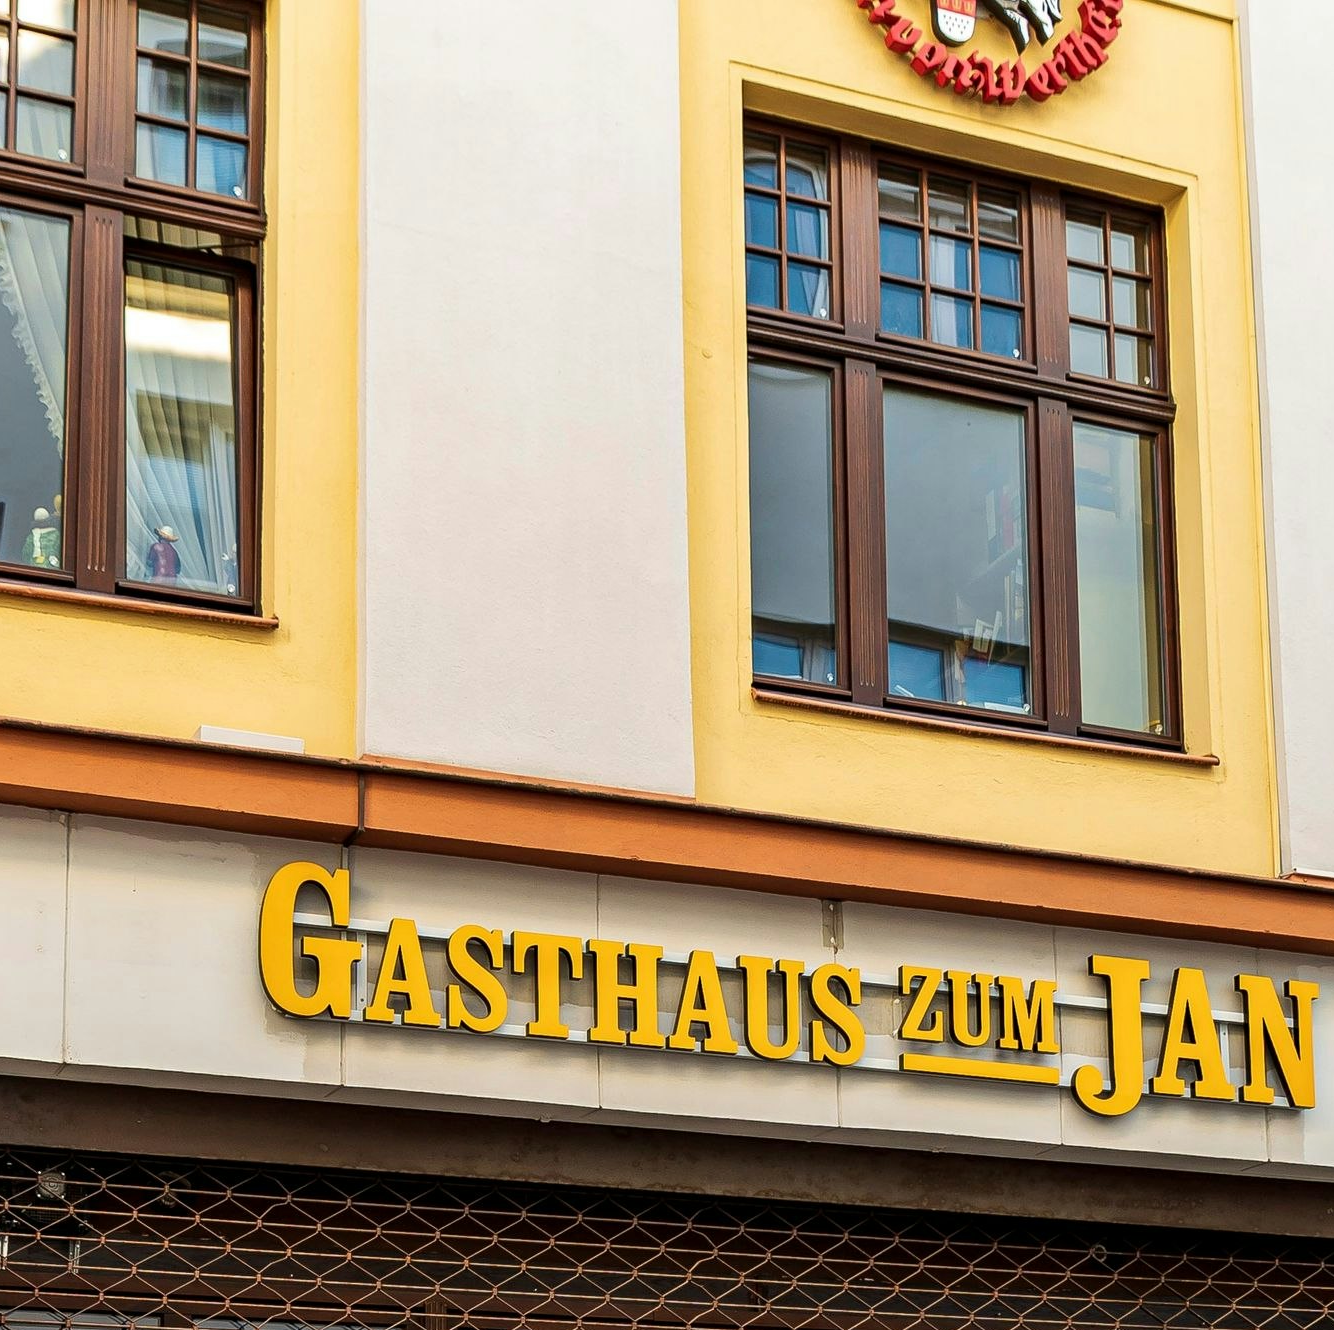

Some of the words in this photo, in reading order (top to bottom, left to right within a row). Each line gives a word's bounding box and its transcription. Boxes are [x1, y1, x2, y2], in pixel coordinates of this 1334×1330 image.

[257, 859, 867, 1066] GASTHAUS
[896, 964, 1060, 1055] ZUM
[1069, 954, 1320, 1117] JAN
